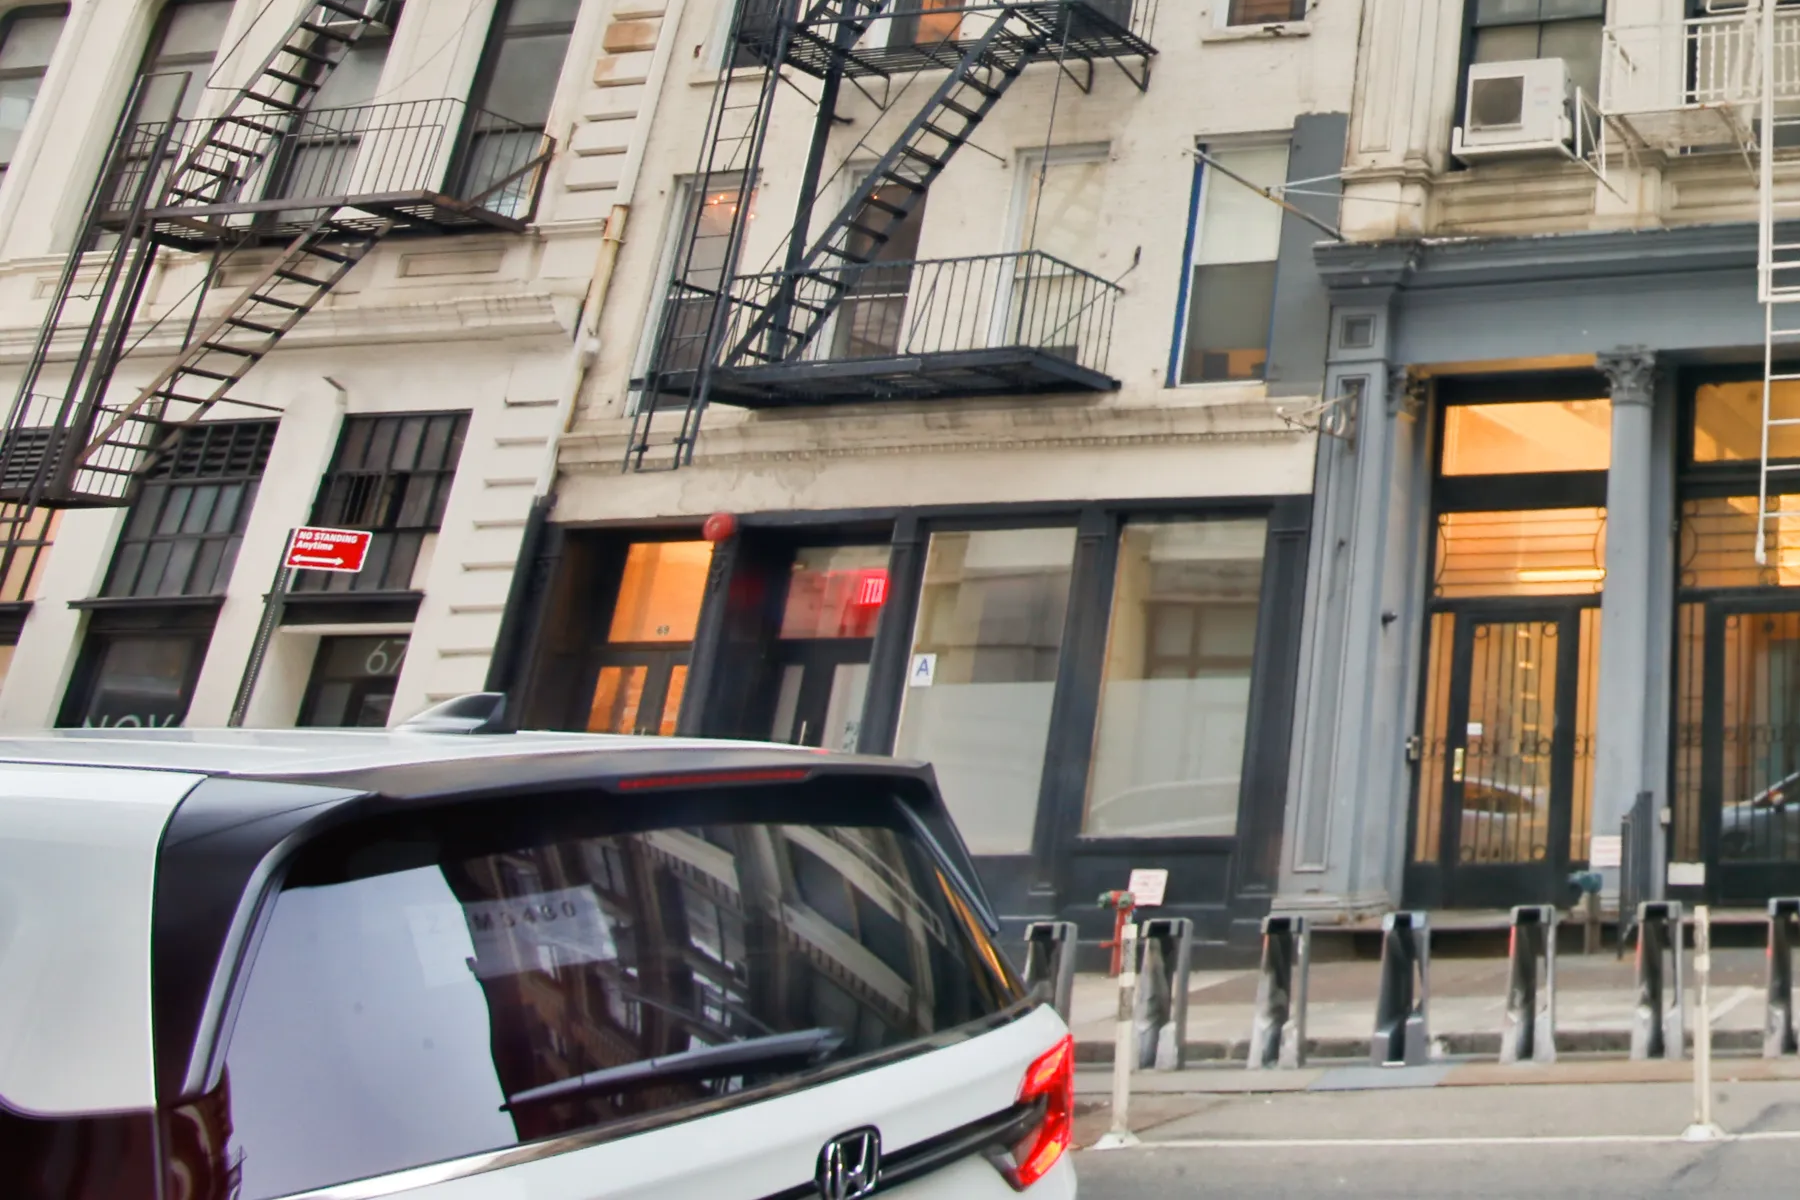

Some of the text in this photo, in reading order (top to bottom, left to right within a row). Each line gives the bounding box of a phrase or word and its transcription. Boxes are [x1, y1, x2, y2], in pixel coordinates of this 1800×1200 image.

[296, 540, 334, 551] Anytime
[299, 531, 358, 544] NO STANDING
[366, 639, 409, 675] 67
[915, 656, 930, 676] A
